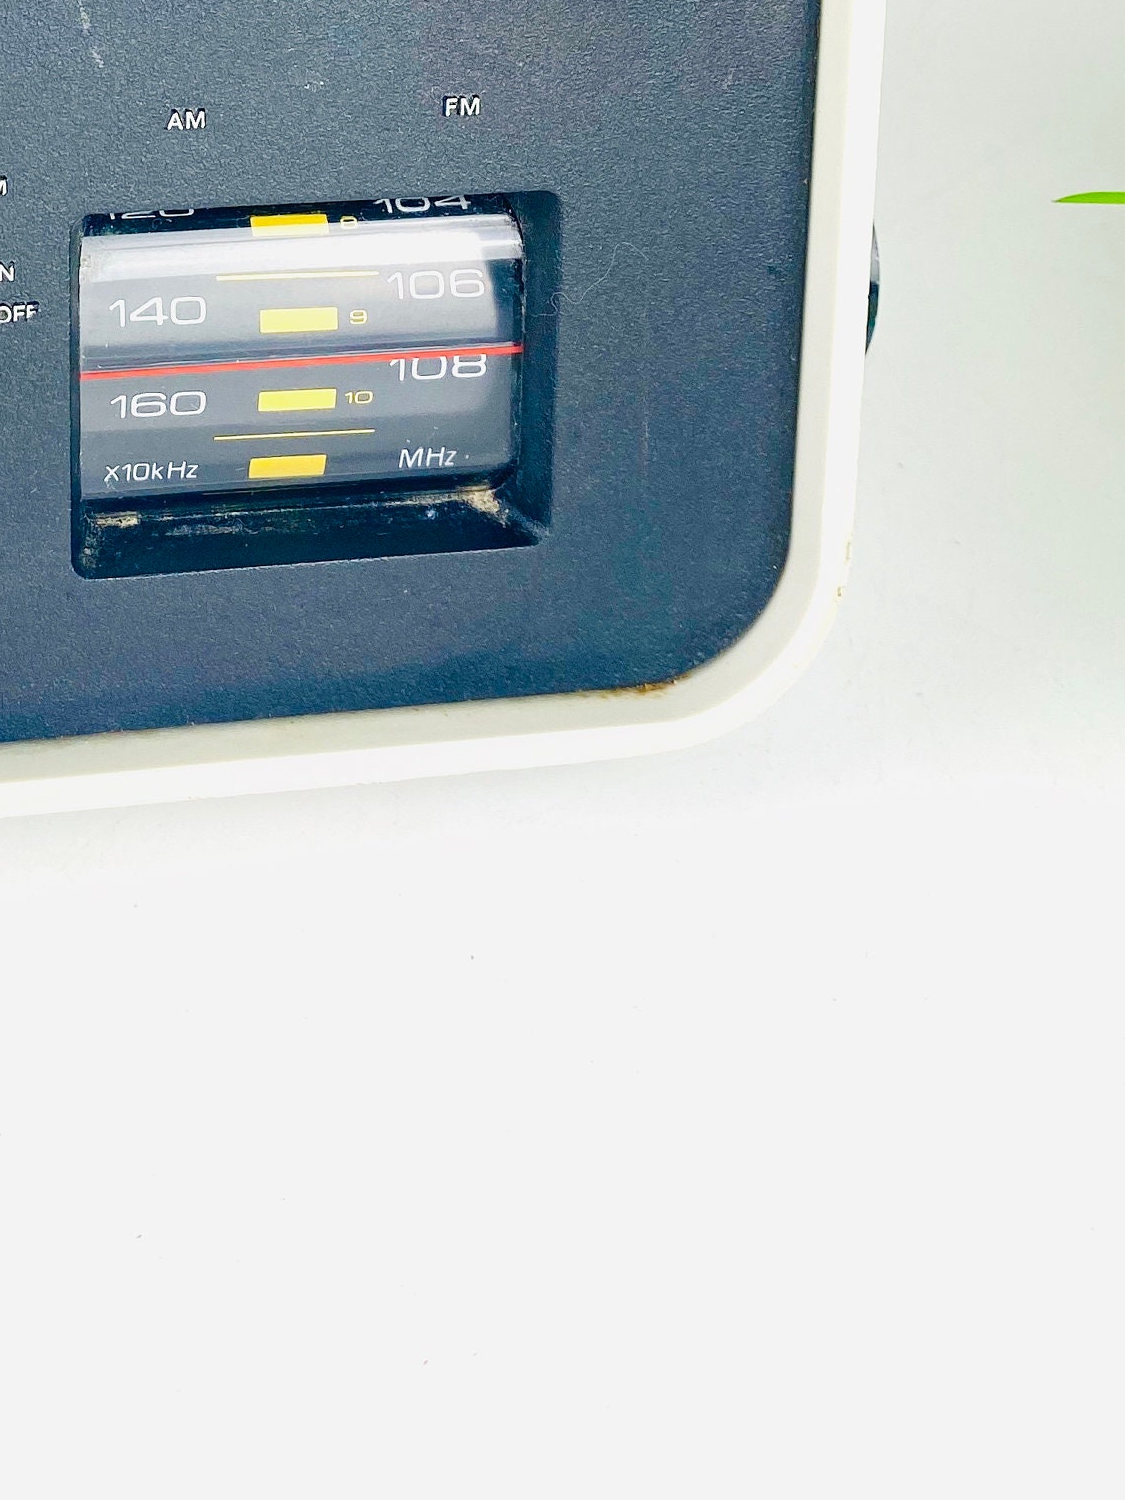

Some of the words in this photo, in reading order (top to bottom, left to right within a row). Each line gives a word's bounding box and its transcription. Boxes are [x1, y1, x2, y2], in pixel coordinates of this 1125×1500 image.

[444, 97, 481, 116] FM
[167, 110, 206, 130] AM
[386, 269, 486, 300] 106
[108, 296, 207, 328] 140
[349, 309, 369, 325] 9
[389, 354, 487, 382] 108
[109, 390, 207, 419] 160
[344, 390, 374, 405] 10
[398, 447, 457, 468] MHz
